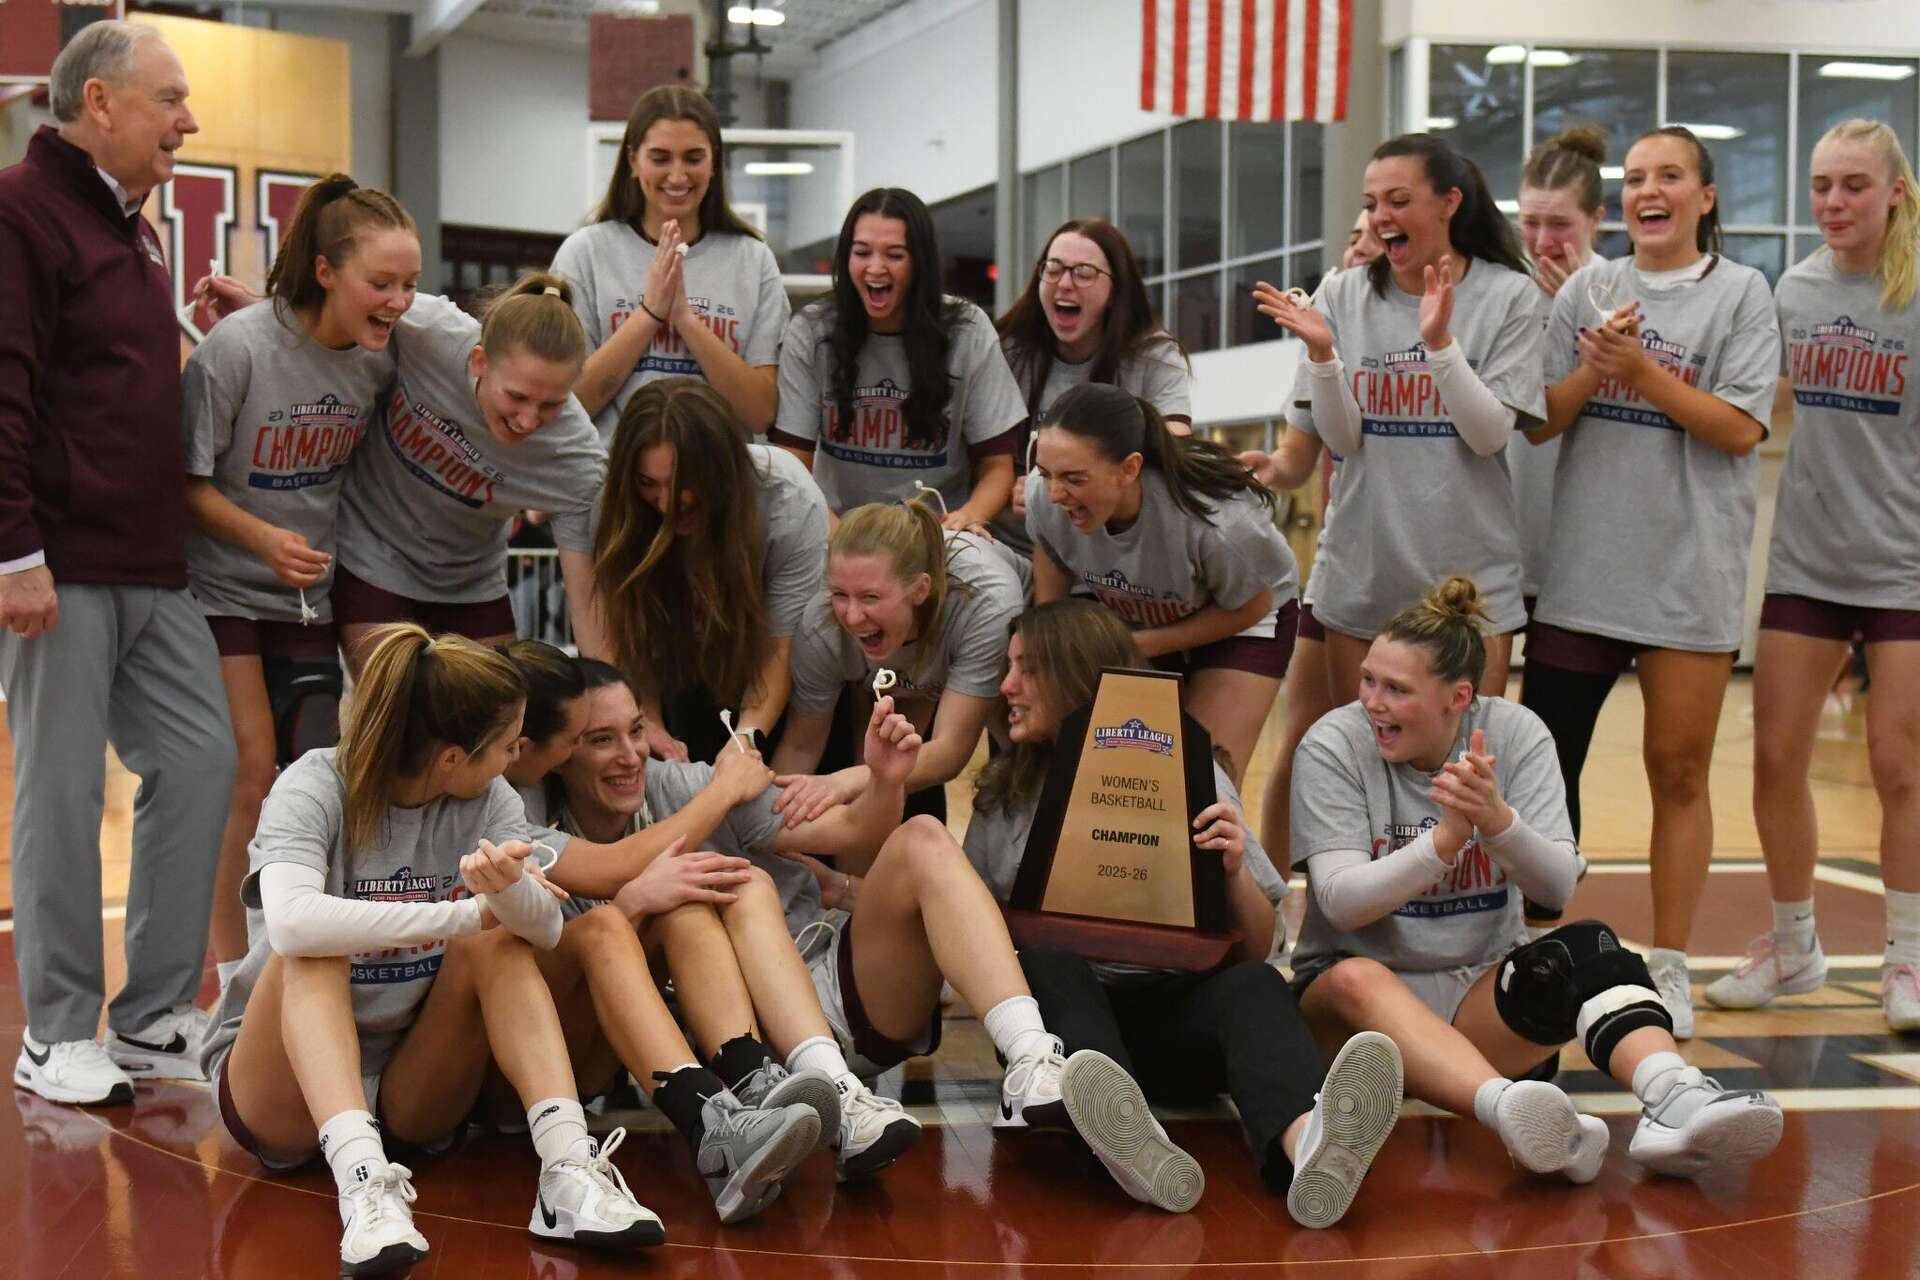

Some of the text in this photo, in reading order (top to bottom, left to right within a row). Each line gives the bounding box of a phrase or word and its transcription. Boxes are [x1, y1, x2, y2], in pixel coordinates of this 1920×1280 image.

[1881, 338, 1905, 351] 26
[1360, 356, 1379, 369] 20
[1384, 351, 1423, 364] LIBERTY
[291, 404, 328, 417] LIBERTY
[330, 403, 359, 417] LEAGUE
[1096, 727, 1136, 739] LIBERTY
[1138, 730, 1174, 745] LEAGUE
[1101, 774, 1160, 793] WOMEN'S
[1091, 791, 1167, 812] BASKETBALL
[1091, 828, 1160, 847] CHAMPION
[1097, 863, 1148, 881] 2025-26
[356, 879, 407, 893] LIBERTY
